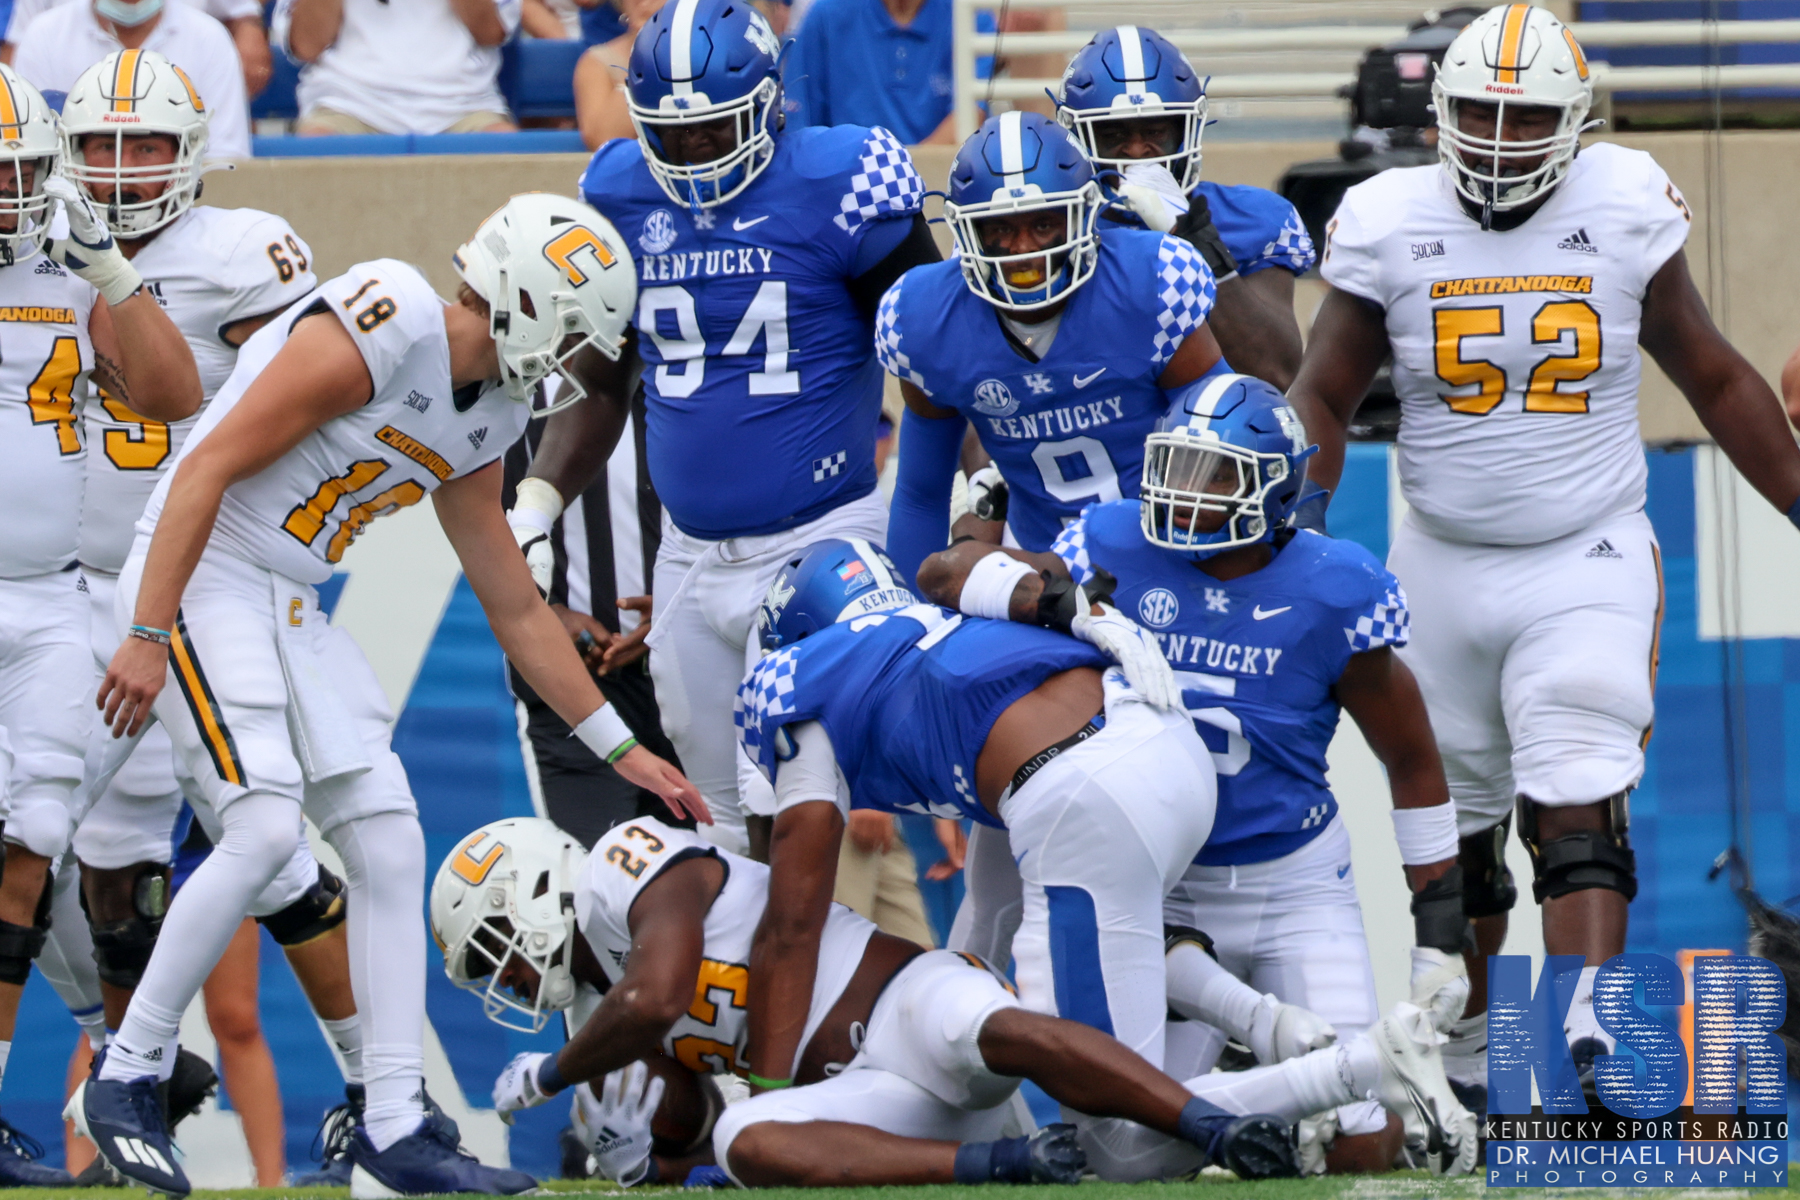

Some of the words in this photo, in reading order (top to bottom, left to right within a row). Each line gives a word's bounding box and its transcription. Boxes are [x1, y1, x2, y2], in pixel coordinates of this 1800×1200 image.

[1485, 84, 1524, 95] Riddell
[646, 210, 672, 242] SEC
[266, 234, 307, 284] 69
[1411, 239, 1446, 261] SOCON
[1557, 241, 1598, 253] adidas
[34, 266, 67, 278] adidas
[642, 247, 773, 281] KENTUCKY
[1430, 274, 1594, 299] CHATTANOOGA
[341, 278, 399, 334] 18
[638, 280, 800, 399] 94
[1432, 299, 1603, 417] 52
[977, 382, 1009, 408] SEC
[1023, 372, 1054, 395] UK
[987, 395, 1125, 439] KENTUCKY
[1173, 530, 1198, 543] Riddll
[289, 597, 303, 628] C
[1143, 591, 1174, 624] SEC
[1204, 587, 1230, 614] UK
[1154, 631, 1283, 676] NTUCKY
[606, 824, 666, 881] 23
